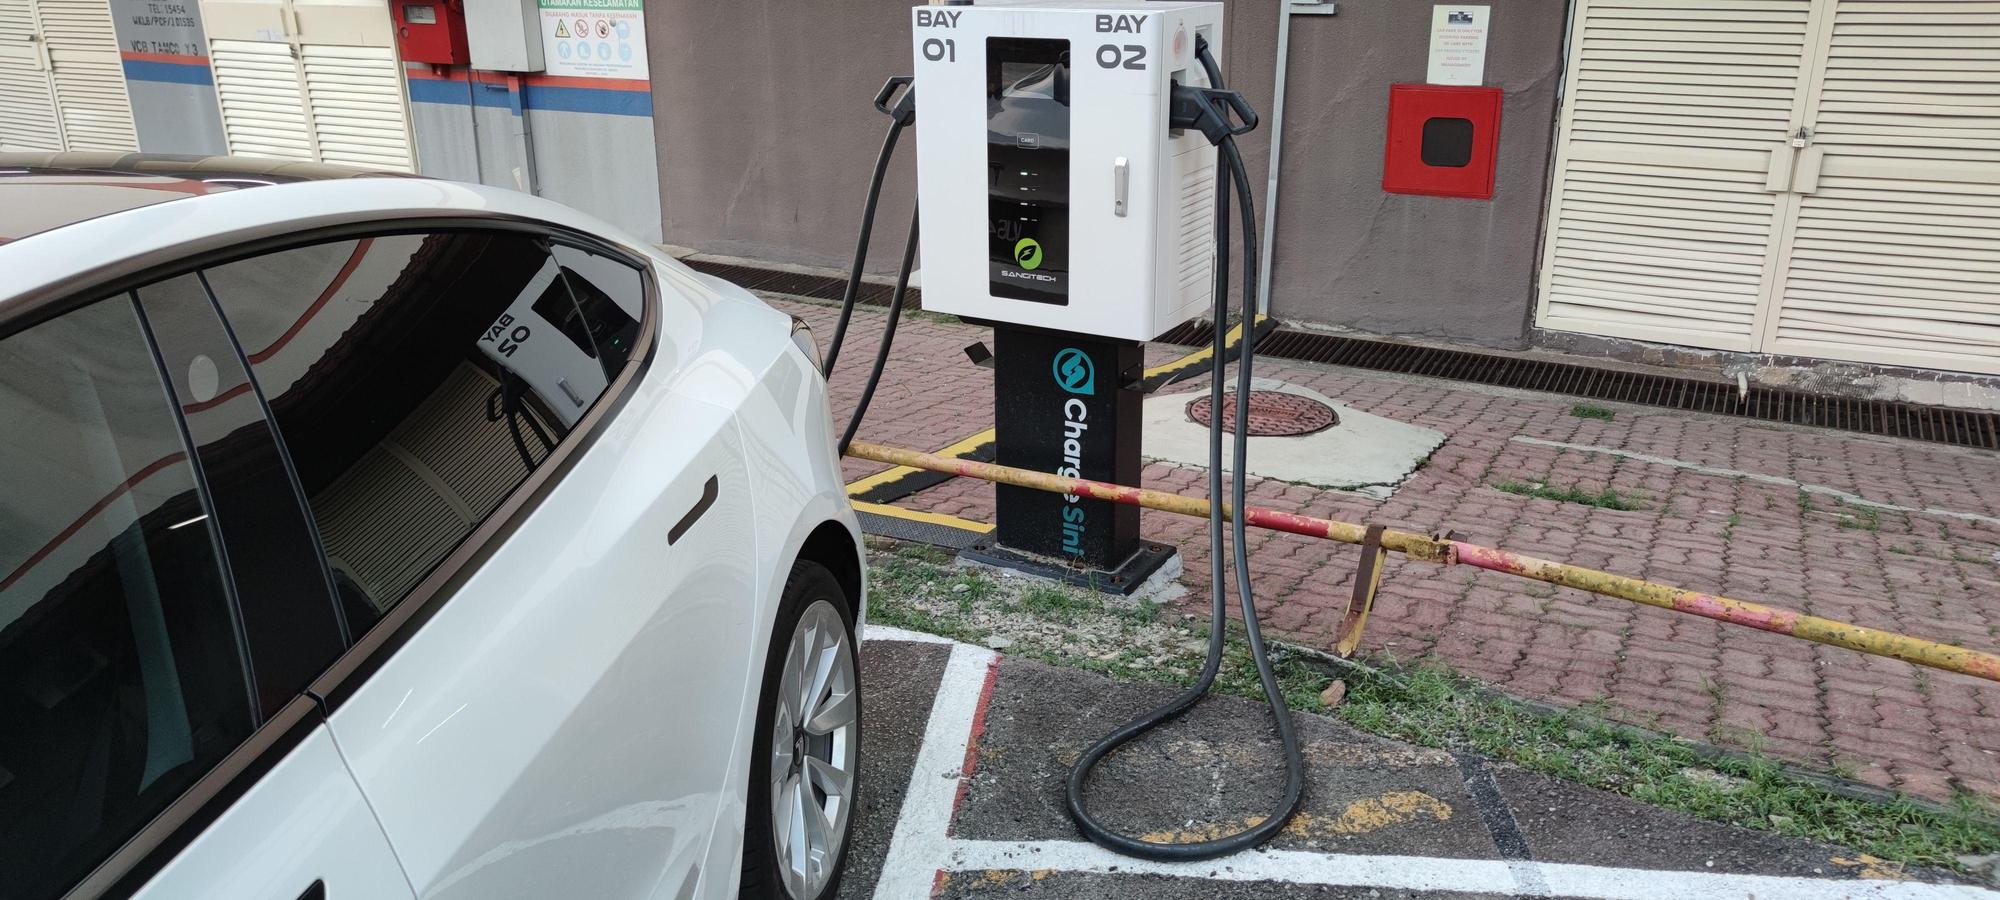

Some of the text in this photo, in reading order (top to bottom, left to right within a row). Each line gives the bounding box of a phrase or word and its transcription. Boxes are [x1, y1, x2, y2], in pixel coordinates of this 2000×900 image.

[917, 10, 962, 28] BAY
[1095, 14, 1148, 33] BAY
[130, 40, 148, 53] VCB
[922, 38, 955, 63] 01
[1096, 44, 1147, 70] 02
